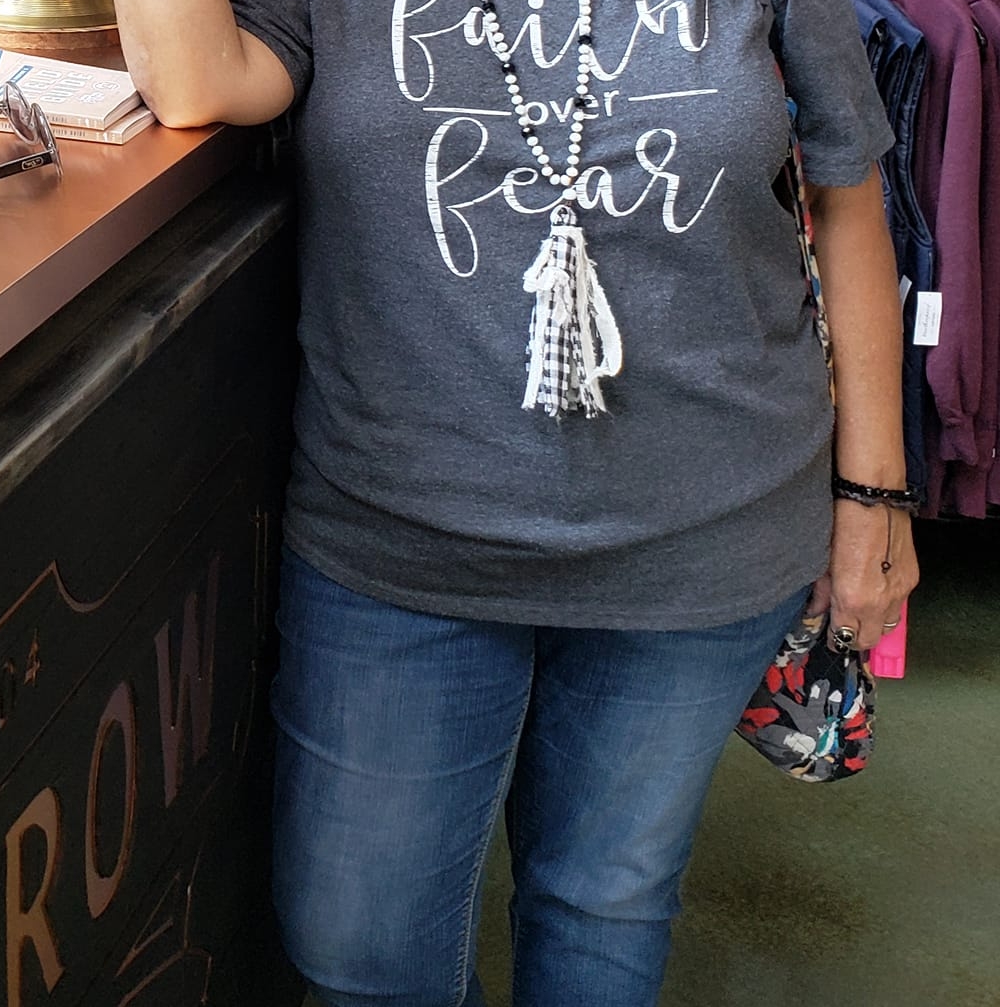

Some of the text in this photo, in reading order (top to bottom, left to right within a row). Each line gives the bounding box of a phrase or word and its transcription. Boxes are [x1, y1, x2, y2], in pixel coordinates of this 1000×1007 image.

[523, 86, 620, 126] over
[425, 117, 725, 278] fear
[5, 548, 223, 1007] ROW
